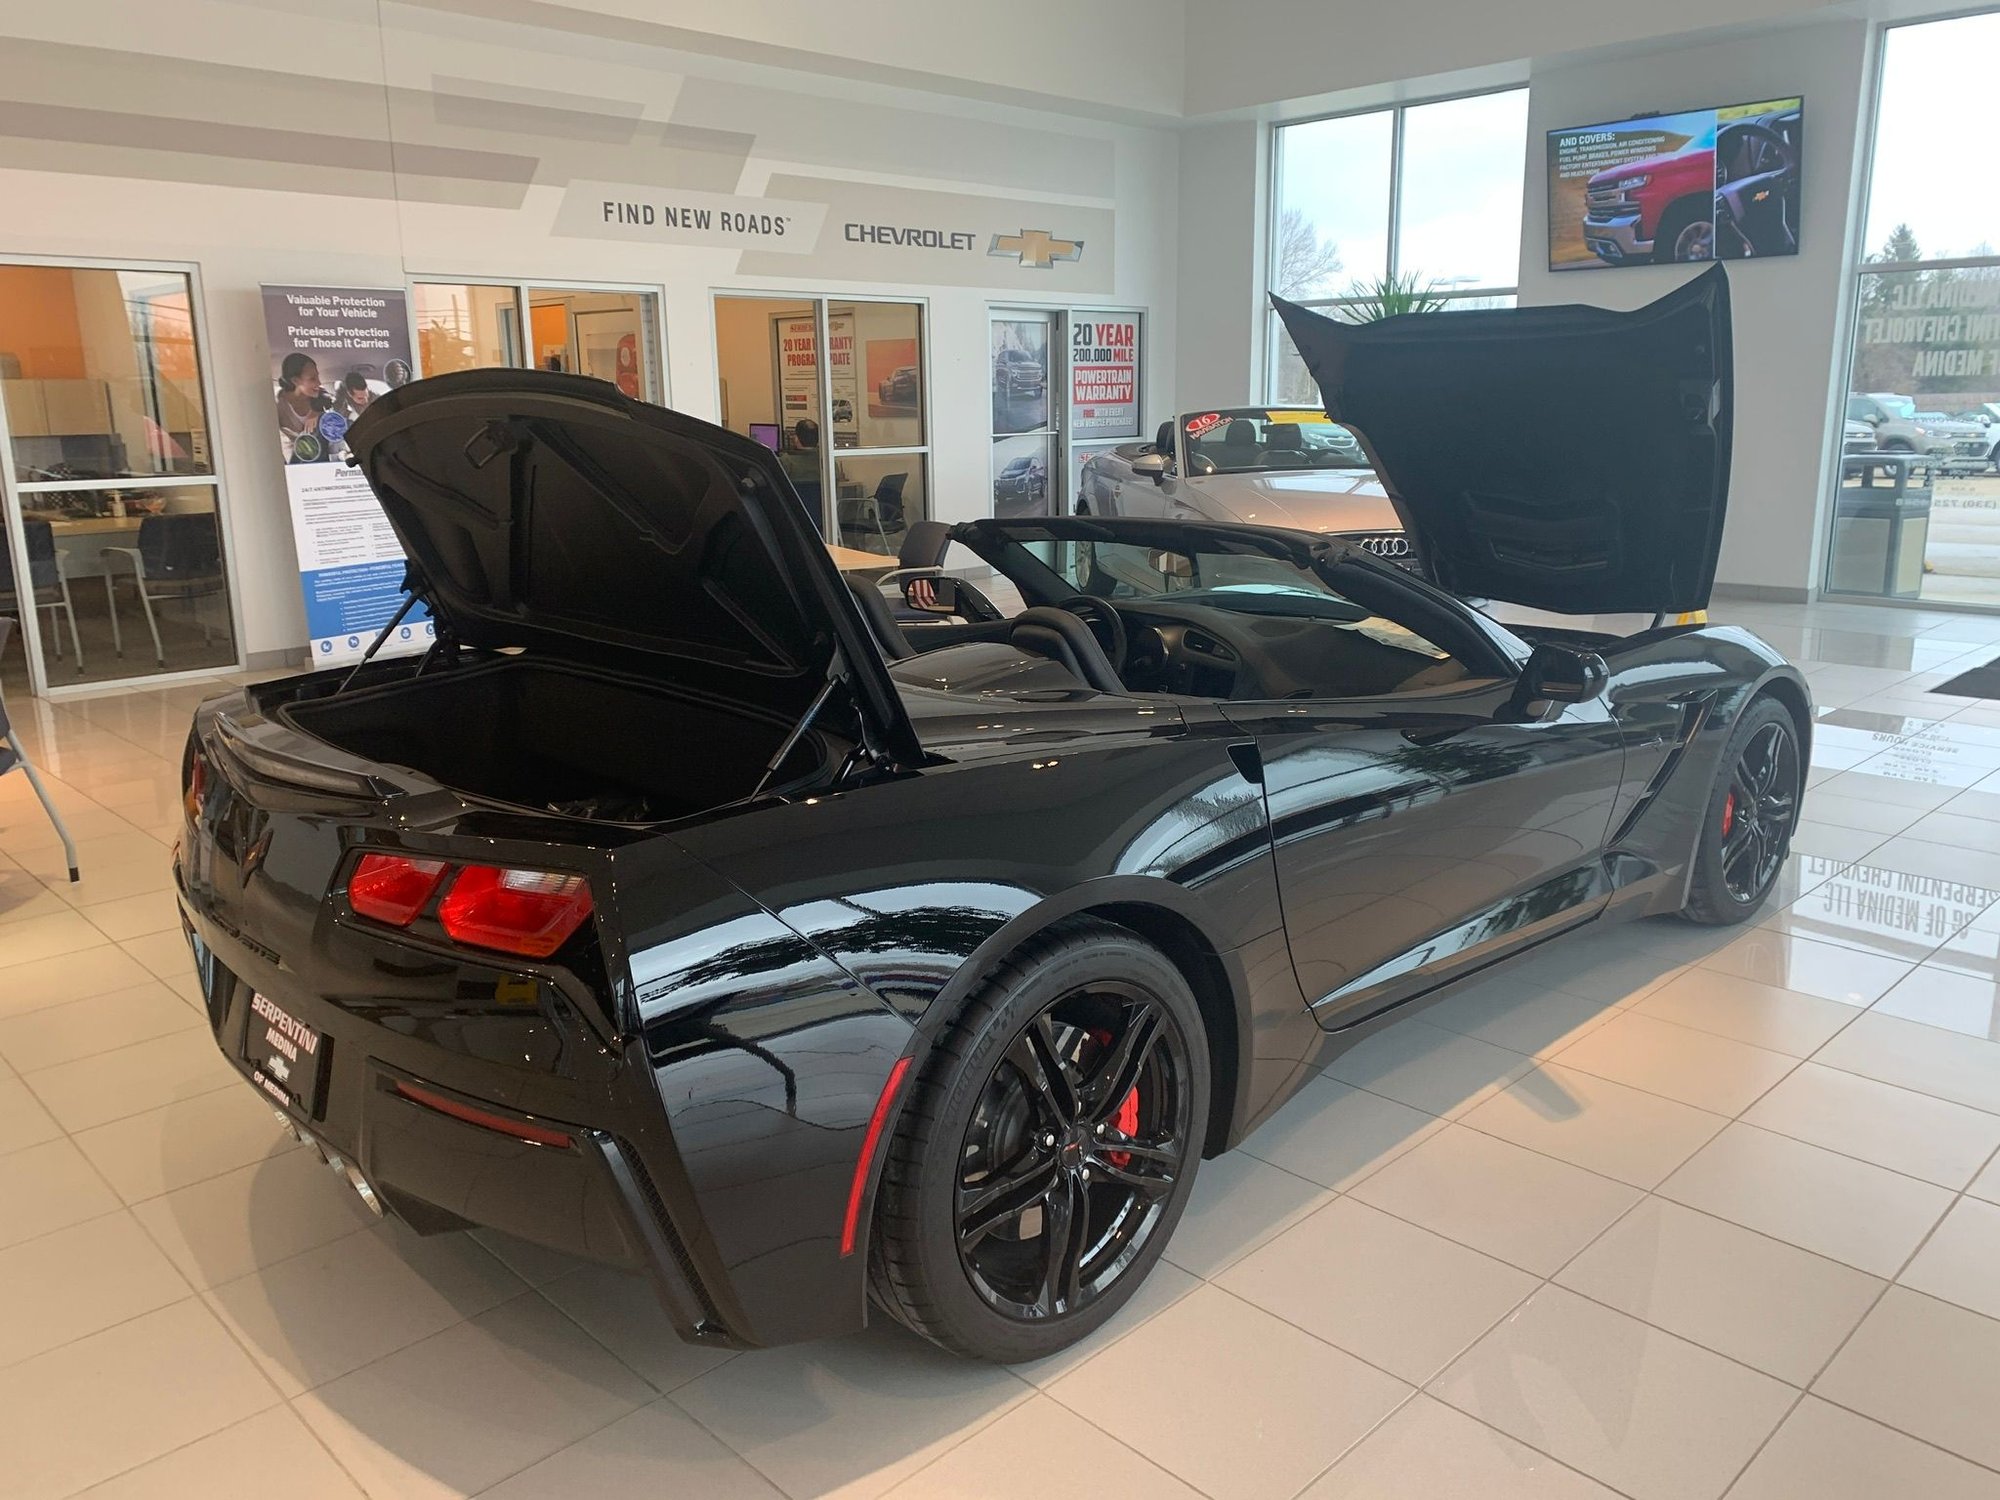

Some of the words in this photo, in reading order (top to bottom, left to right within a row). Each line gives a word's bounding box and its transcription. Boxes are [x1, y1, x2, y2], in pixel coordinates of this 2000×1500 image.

[1559, 138, 1577, 147] AND
[1578, 132, 1616, 145] COVERS:
[602, 201, 655, 226] FIND
[665, 206, 711, 230] NEW
[844, 223, 976, 251] CHEVROLET
[286, 294, 331, 306] Valuable
[332, 295, 386, 308] Protection
[298, 307, 314, 317] for
[315, 307, 340, 317] Your
[341, 307, 378, 318] Vehicle
[287, 325, 336, 337] Priceless
[337, 326, 390, 338] Protection
[1073, 323, 1092, 346] 20
[1095, 324, 1134, 347] YEAR
[293, 337, 309, 348] for
[310, 337, 343, 349] Those
[353, 338, 390, 349] Carries
[783, 338, 793, 352] 20
[793, 337, 812, 351] YEAR
[787, 353, 816, 367] PROGRA
[829, 352, 851, 366] PDATE
[1073, 348, 1111, 363] 200,000
[1112, 348, 1134, 362] MILE
[1075, 369, 1132, 385] POWERTRAIN
[1075, 385, 1132, 401] WARRANTY
[1856, 888, 1920, 934] MEDINA
[1923, 903, 1947, 940] OF
[251, 992, 318, 1055] SERPENTINI
[265, 1027, 298, 1062] MEDINA
[253, 1070, 265, 1083] OF
[263, 1078, 290, 1107] MEDINA
